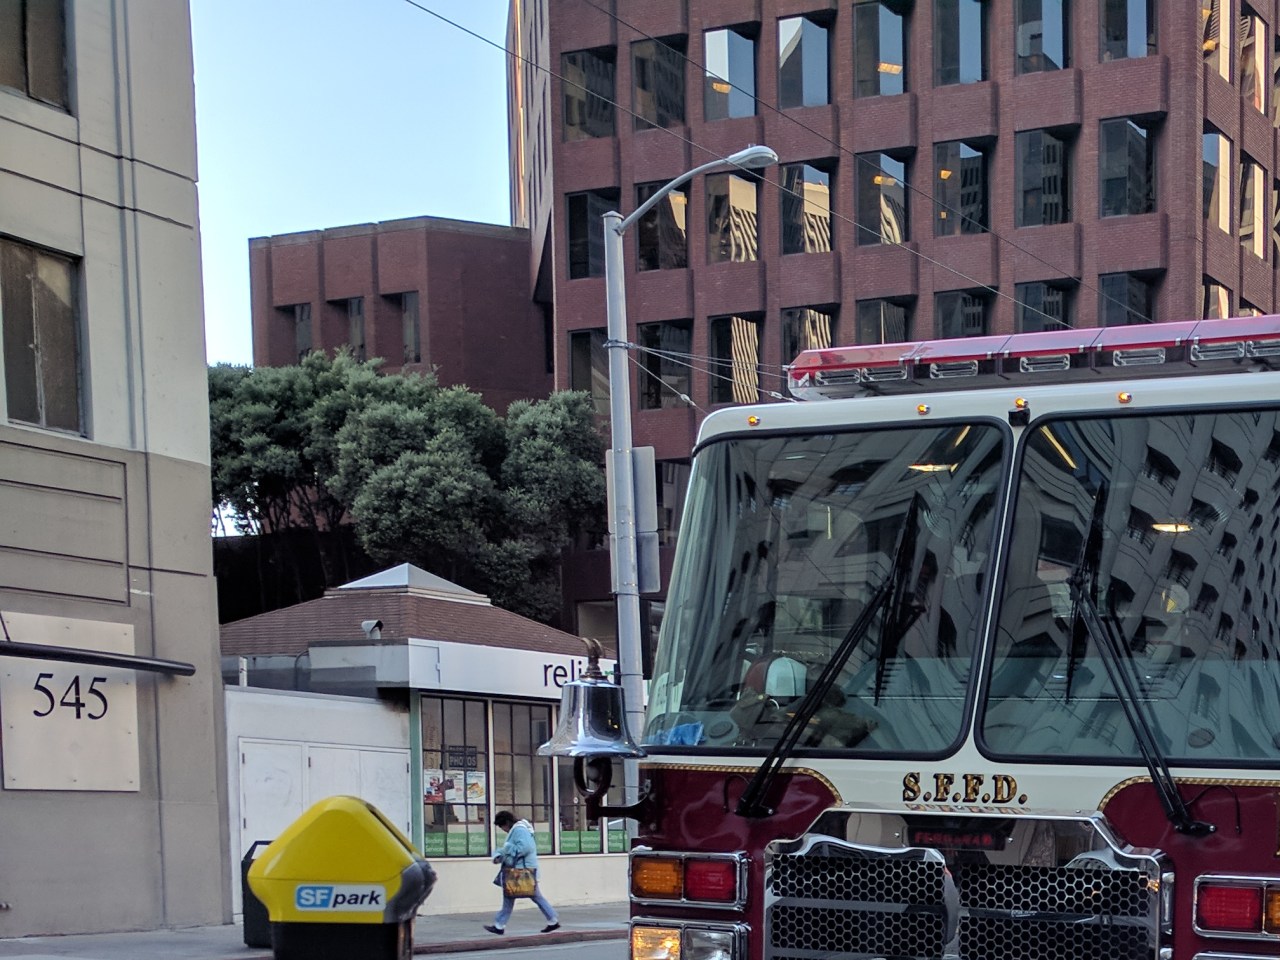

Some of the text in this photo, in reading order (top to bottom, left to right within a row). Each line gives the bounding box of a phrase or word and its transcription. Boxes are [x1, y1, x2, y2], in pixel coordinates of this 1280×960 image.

[543, 659, 583, 688] reli
[33, 673, 108, 720] 545
[449, 756, 477, 767] PHOOS
[903, 772, 1028, 805] S.F.F.D.
